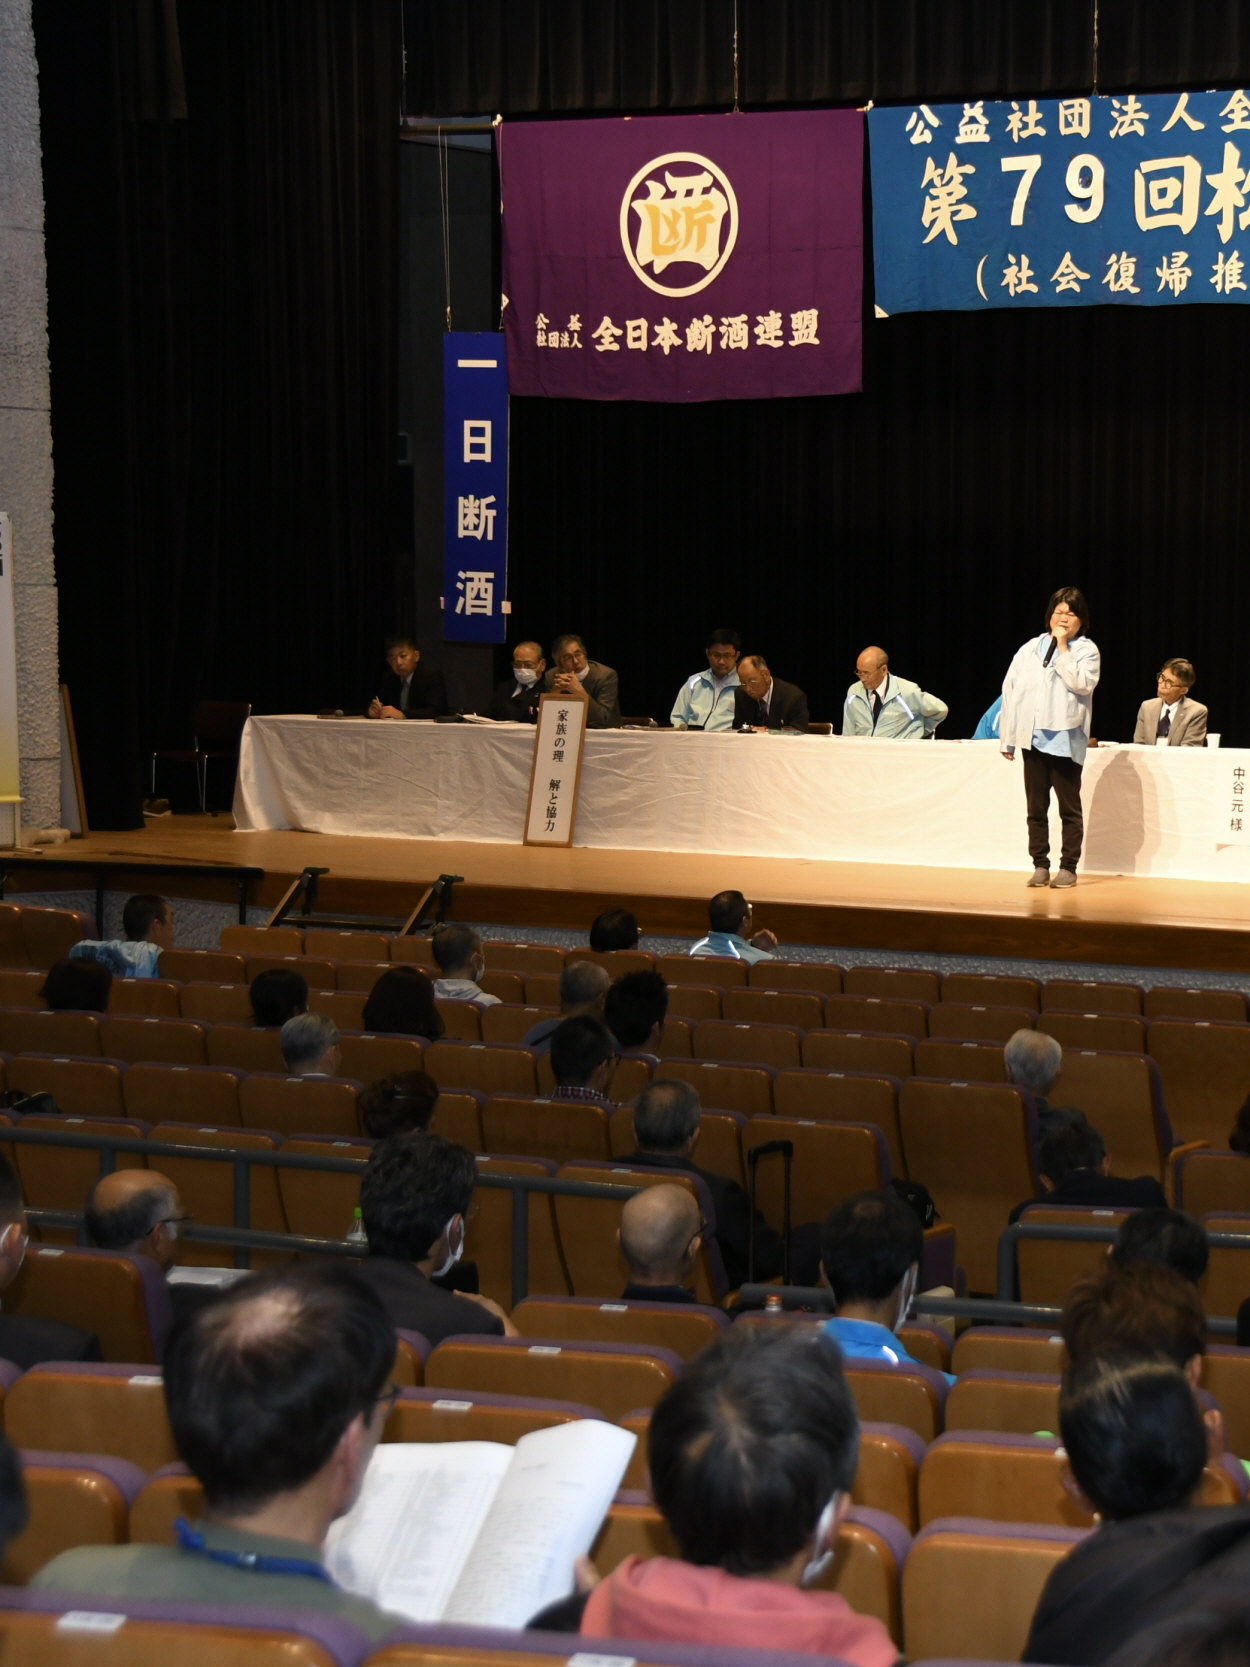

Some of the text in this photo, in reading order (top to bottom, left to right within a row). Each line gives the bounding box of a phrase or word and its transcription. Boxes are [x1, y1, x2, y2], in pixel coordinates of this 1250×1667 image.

[592, 308, 820, 355] 全日本断酒連盟
[455, 360, 497, 616] 一日断酒
